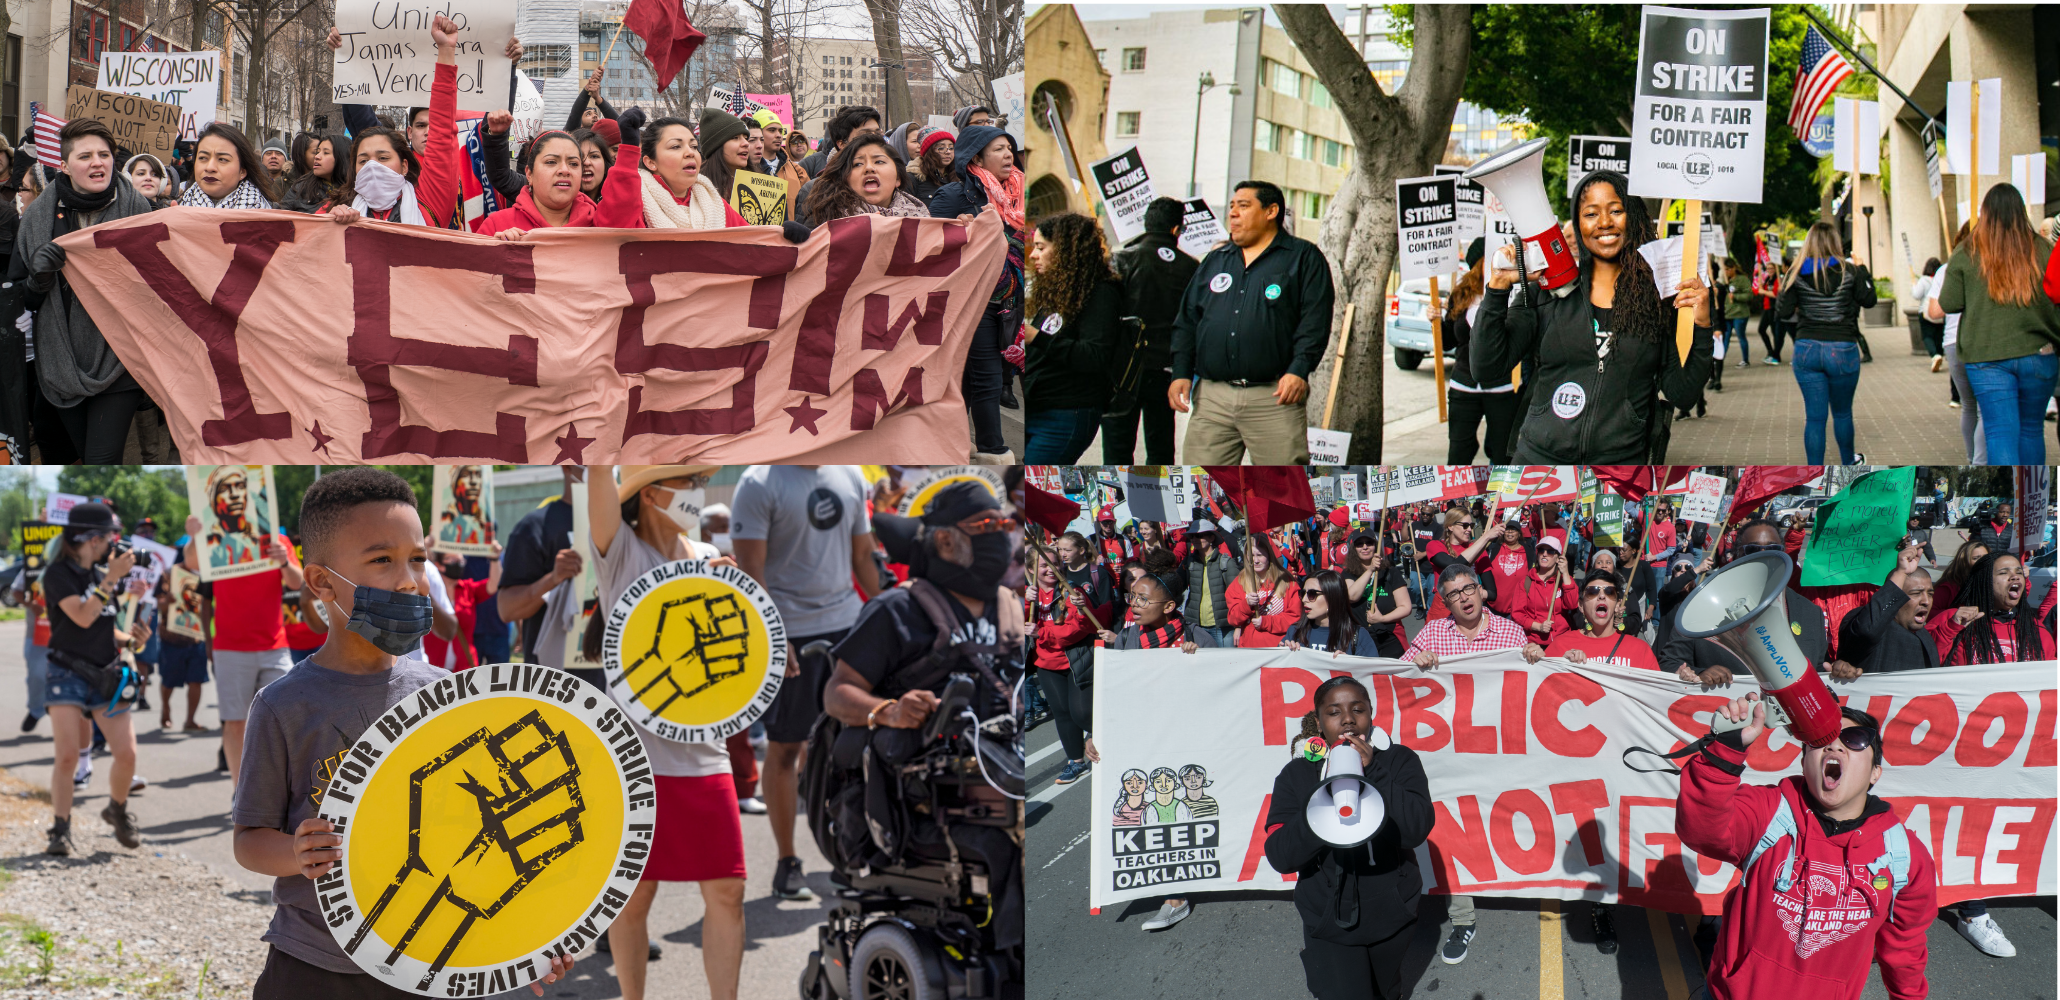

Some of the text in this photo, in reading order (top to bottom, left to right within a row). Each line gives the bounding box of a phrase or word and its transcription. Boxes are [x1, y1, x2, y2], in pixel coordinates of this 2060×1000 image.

[336, 32, 485, 63] Jamas sra
[1685, 27, 1727, 56] ON
[105, 55, 214, 87] WISCONSIN
[372, 59, 484, 95] Venco!!
[1652, 61, 1755, 93] STRIKE
[75, 88, 183, 127] WISCONSIN
[514, 98, 541, 112] OOK
[1650, 103, 1752, 125] FOR A FAIR
[112, 118, 146, 139] NOT
[1650, 127, 1749, 150] CONTRACT
[114, 137, 150, 155] ZONA
[1598, 143, 1616, 157] ON
[1111, 156, 1131, 175] ON
[1585, 158, 1627, 172] STRIKE
[1657, 161, 1679, 171] LOCAL
[1717, 165, 1735, 174] 1018
[479, 160, 498, 219] hivas
[1104, 166, 1147, 197] STRIKE
[1112, 184, 1151, 209] FOR A FAIR
[1418, 185, 1439, 203] ON
[1456, 188, 1482, 203] RIKE
[1116, 194, 1154, 218] CONTRACT
[1404, 204, 1453, 225] STRIKE
[1183, 210, 1212, 225] TRIKE
[1181, 227, 1194, 235] OR
[1202, 222, 1217, 230] FAIR
[1184, 229, 1220, 241] CONTRACT
[1406, 225, 1453, 241] FOR A FAIR
[1408, 237, 1453, 254] CONTRACT
[1309, 452, 1340, 464] CONTRA
[1404, 465, 1433, 477] KEEP
[1441, 466, 1493, 488] TEACHERS
[1584, 469, 1592, 479] ON
[1371, 483, 1400, 494] OAKAND
[1406, 476, 1435, 488] OAKLAND
[1581, 478, 1598, 490] STRIKE
[1864, 474, 1876, 493] it
[1881, 472, 1902, 493] for
[1602, 496, 1614, 508] ON
[1595, 509, 1620, 523] STRIKE
[1851, 505, 1899, 526] money.
[1847, 523, 1869, 536] NO
[1820, 534, 1882, 552] TEACHER
[1827, 548, 1883, 573] EVER!
[604, 560, 786, 742] STRIKE FOR BLACK LIVES STRIKE FOR BLACK LIVES
[1760, 635, 1792, 679] AMPLIVOX
[489, 665, 581, 705] LIVES
[374, 666, 480, 744] BLACK
[1260, 666, 1608, 758] PUBLIC
[595, 707, 655, 812] STRIKE
[327, 740, 384, 804] FOR
[1115, 823, 1216, 853] KEEP
[1426, 779, 1607, 890] NOT
[1903, 803, 2037, 889] ALE
[614, 823, 654, 881] FOR
[1115, 848, 1215, 868] TEACHERS IN
[317, 813, 354, 928] STRE
[1116, 864, 1217, 888] OAKLAND
[1772, 893, 1871, 921] TEACHE ARE THE HEAR
[1804, 921, 1842, 931] AKLAND
[446, 958, 538, 998] LIVES
